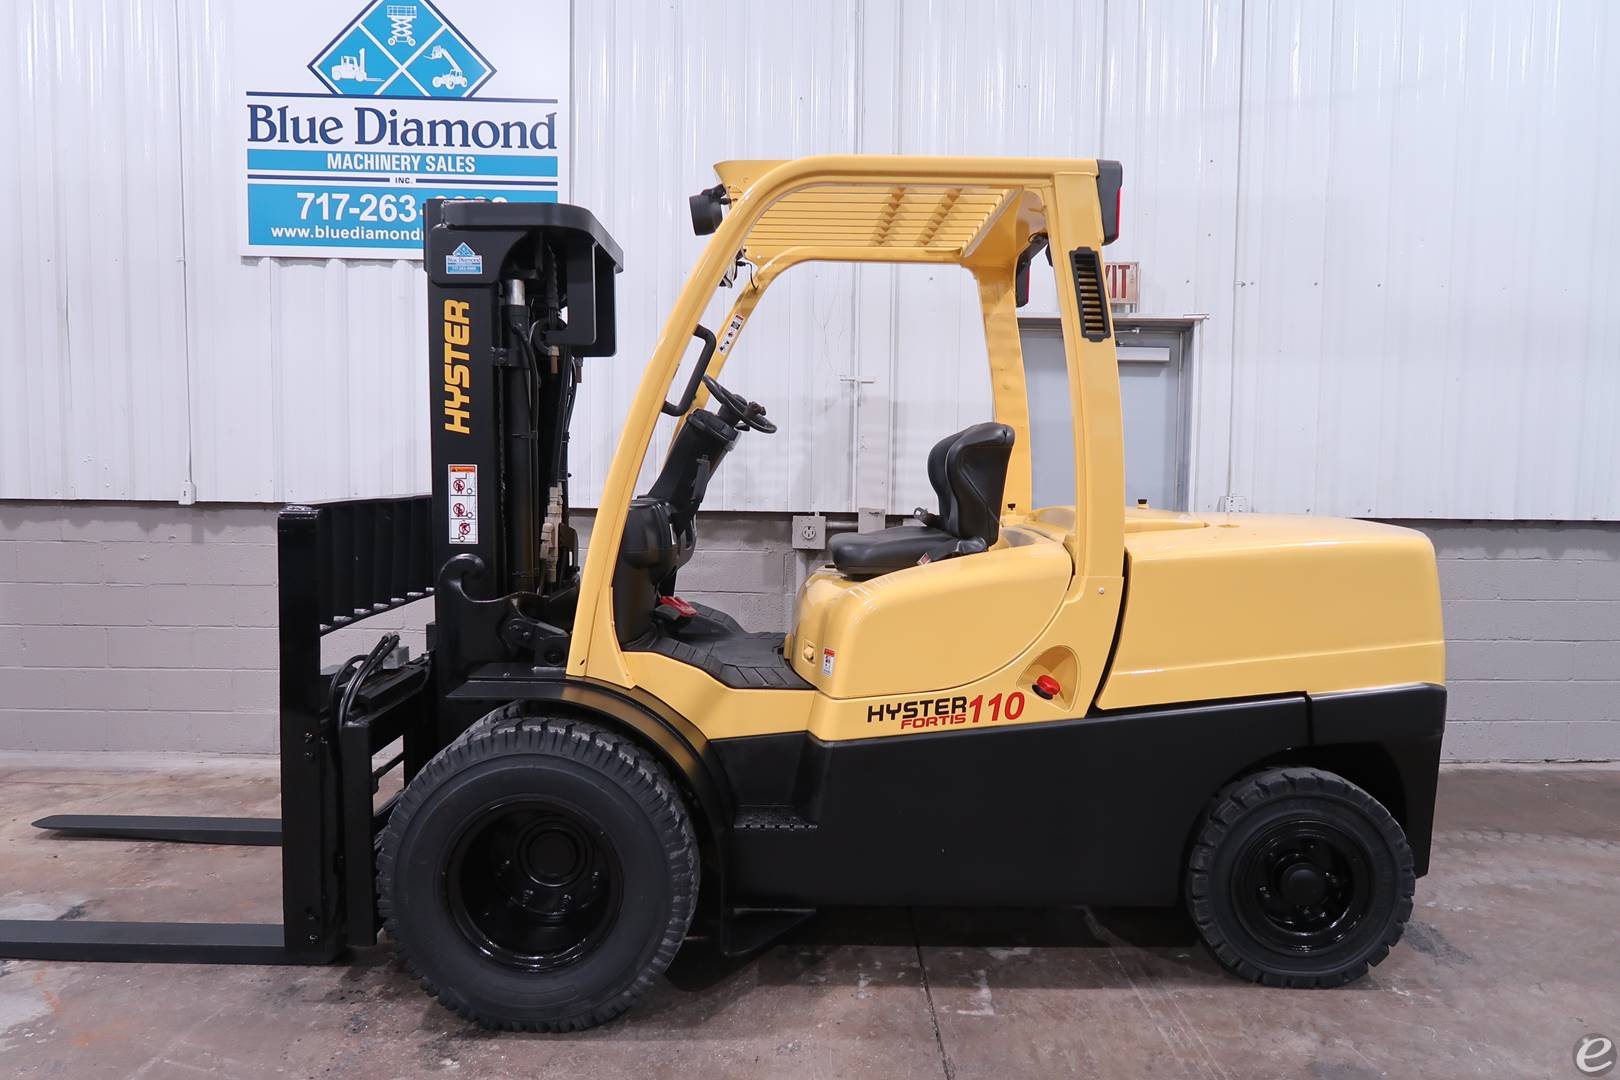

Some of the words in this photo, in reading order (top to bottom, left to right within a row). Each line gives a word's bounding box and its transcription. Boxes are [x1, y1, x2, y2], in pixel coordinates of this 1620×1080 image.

[247, 104, 344, 145] Blue
[354, 106, 558, 149] Diamond
[327, 153, 421, 173] MACHINERY
[426, 156, 476, 173] SALES
[394, 176, 414, 185] INC.
[296, 192, 509, 223] 717-263
[271, 225, 424, 241] www.bluediamond
[444, 299, 470, 434] HYSTER
[867, 696, 967, 722] HYSTER
[968, 691, 1025, 723] 110
[900, 713, 966, 730] FORTIS
